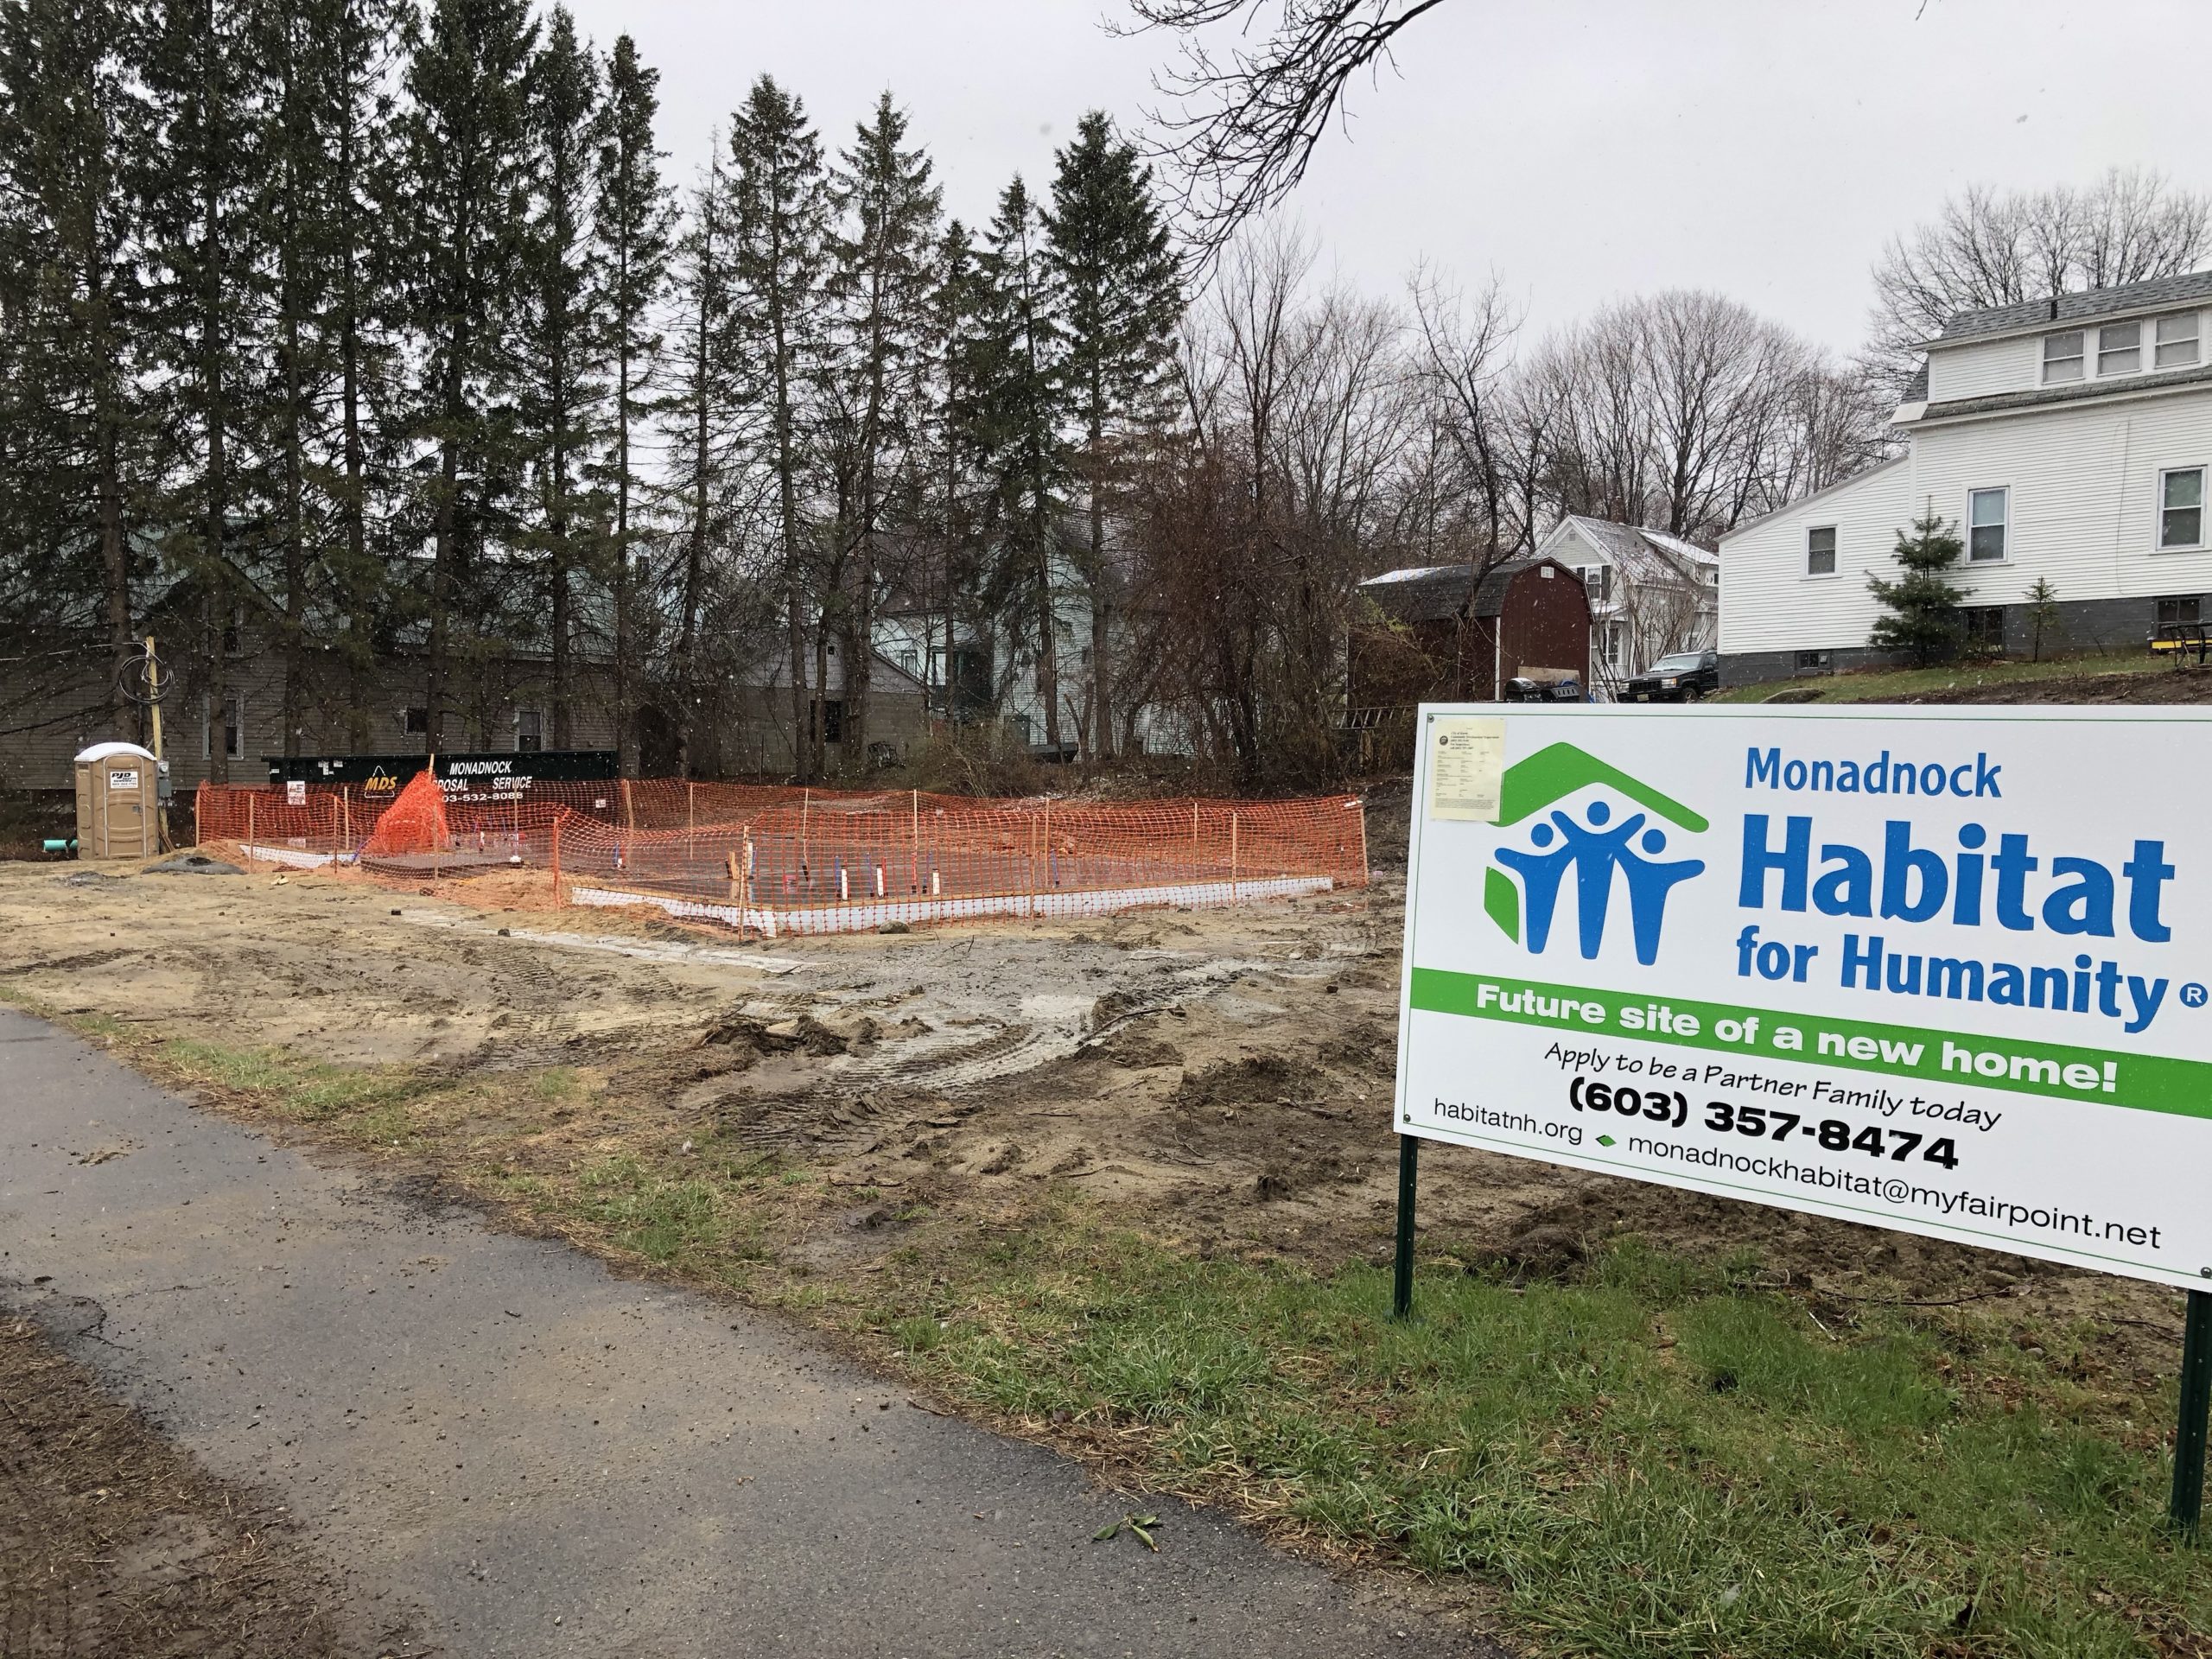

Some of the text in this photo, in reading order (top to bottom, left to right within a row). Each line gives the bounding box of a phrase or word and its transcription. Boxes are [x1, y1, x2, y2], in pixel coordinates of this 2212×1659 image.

[365, 776, 397, 791] MDS
[449, 761, 512, 775] MONADNOCK
[493, 776, 532, 790] SERVICE
[1745, 747, 2002, 798] Monadnock
[442, 792, 524, 803] 03-532-8088
[1738, 813, 2176, 943] Habitat
[1736, 925, 1819, 982] for
[1477, 983, 2118, 1093] Future site of a new home!
[1545, 1042, 2002, 1132] Apply to be a Partner Family today
[1569, 1076, 1959, 1171] (603) 357-8474
[1434, 1097, 2161, 1249] habitatnh.org monadnockhabitat@myfairpoint.net
